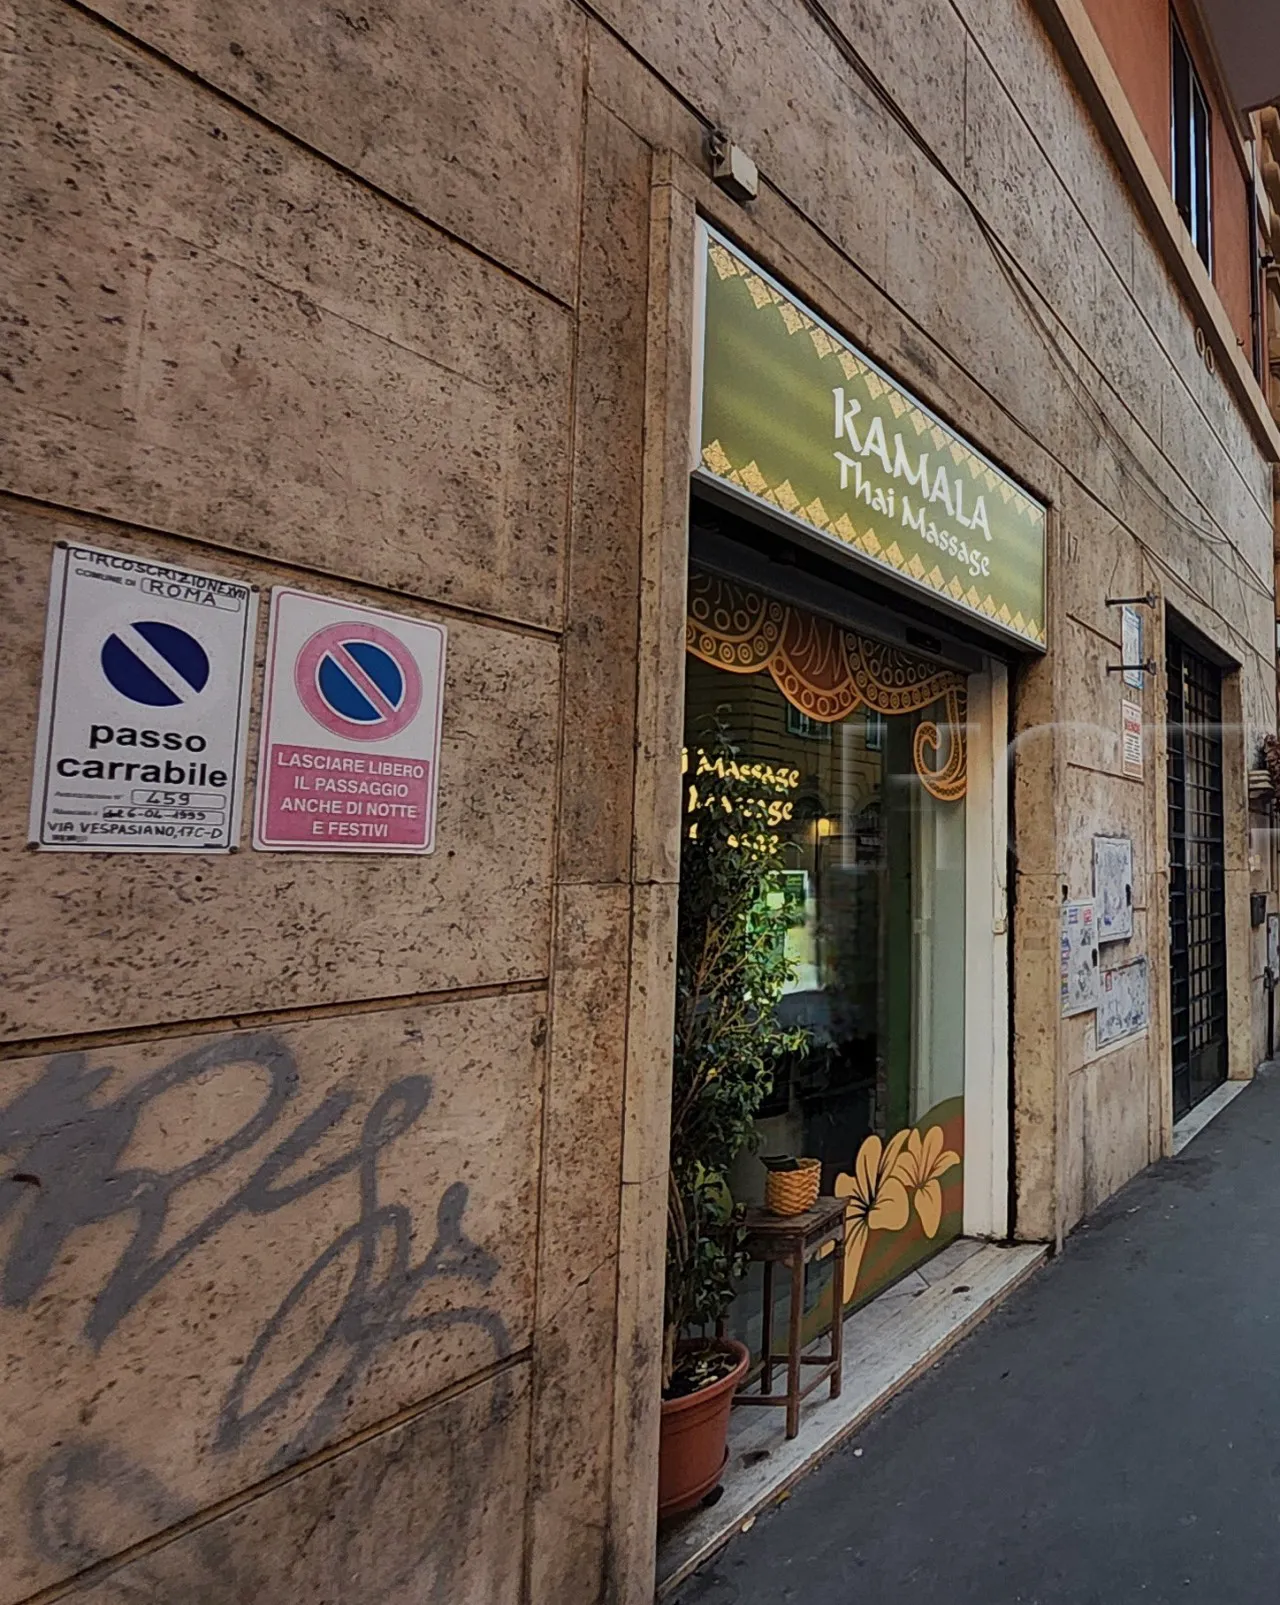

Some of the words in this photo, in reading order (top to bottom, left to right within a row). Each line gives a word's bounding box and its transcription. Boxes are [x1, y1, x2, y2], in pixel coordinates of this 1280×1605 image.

[832, 387, 992, 541] KAMALA
[833, 451, 895, 518] Thai
[902, 496, 990, 577] Massage
[149, 580, 217, 606] ROMA
[89, 724, 207, 753] passo
[56, 758, 228, 787] carrabile
[278, 752, 365, 773] LASCIARE
[369, 762, 425, 779] LIBERO
[294, 775, 311, 790] IL
[315, 777, 409, 798] PASSAGGIO
[280, 797, 342, 814] ANCHE
[346, 801, 362, 815] DI
[366, 802, 418, 818] NOTTE
[47, 821, 74, 833] VIA
[312, 820, 324, 835] E
[328, 821, 388, 837] FESTIVI
